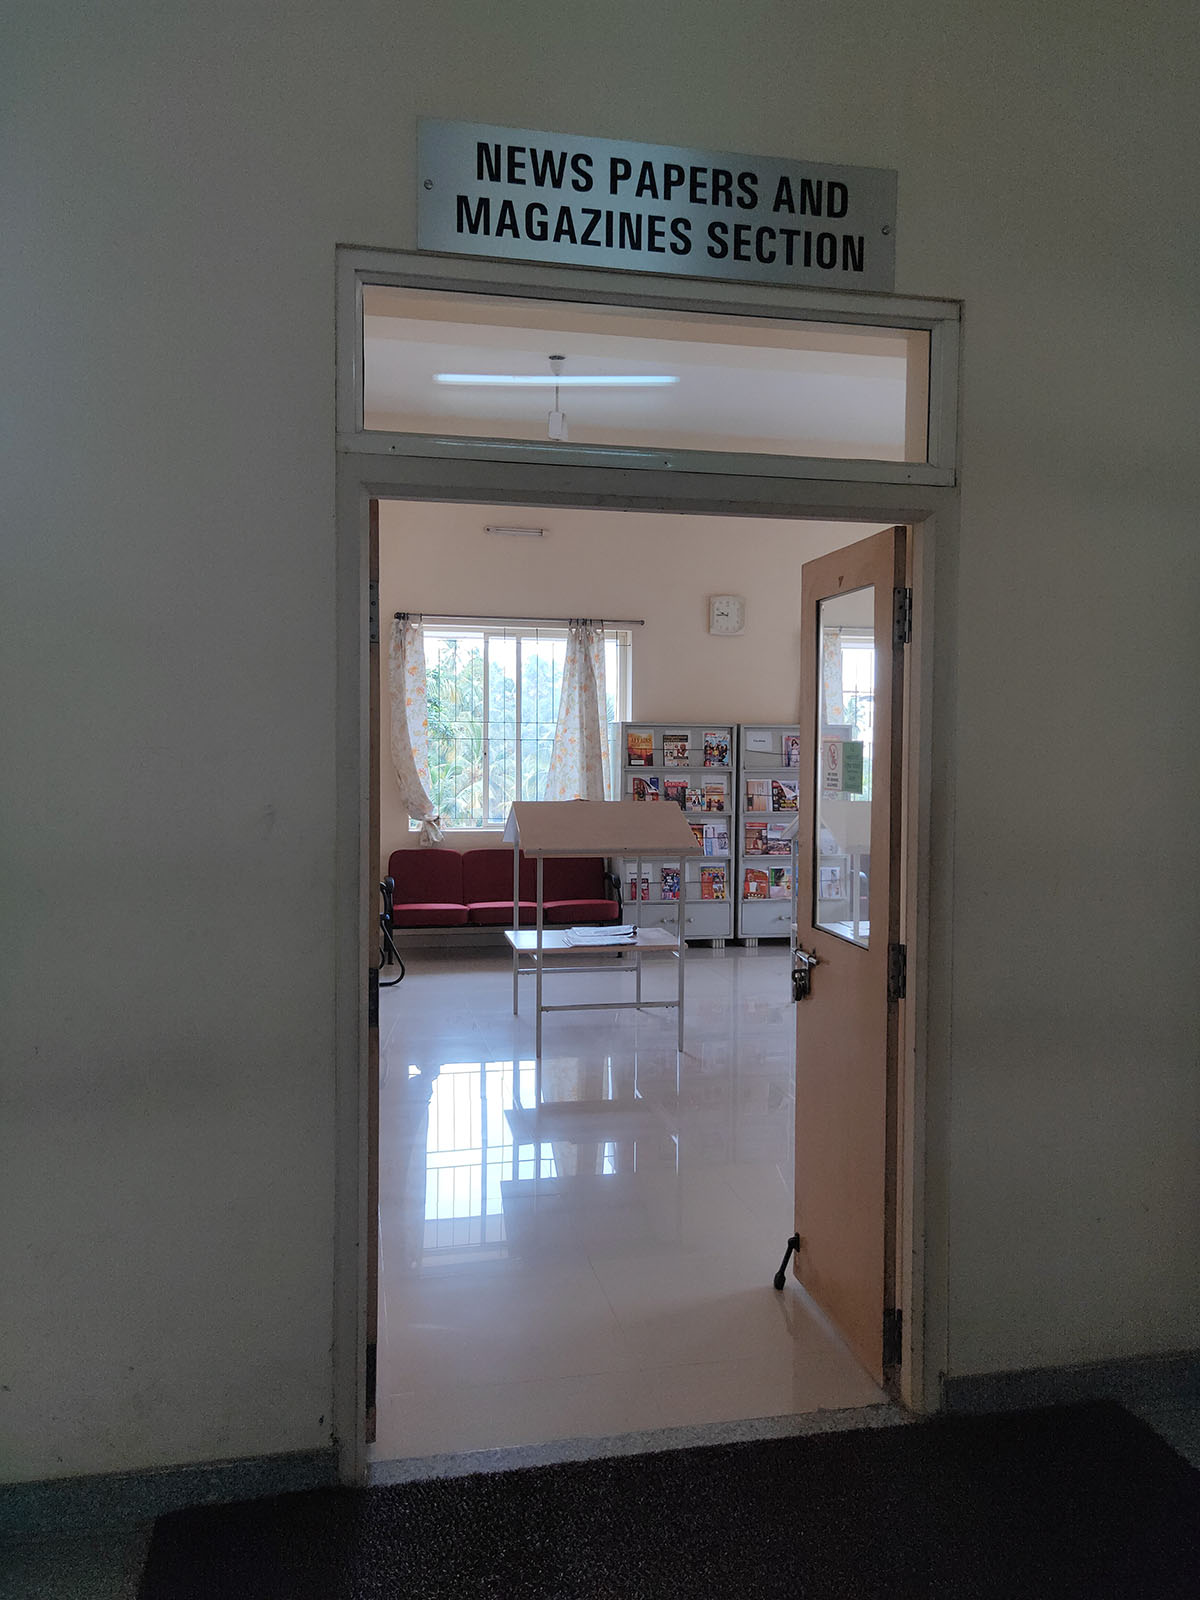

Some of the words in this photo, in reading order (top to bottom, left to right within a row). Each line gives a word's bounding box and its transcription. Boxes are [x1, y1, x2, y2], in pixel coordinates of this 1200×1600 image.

[477, 142, 594, 193] NEWS
[609, 157, 759, 210] PAPERS
[772, 174, 850, 219] AND
[456, 194, 692, 256] MAGAZINES
[706, 221, 865, 273] SECTION
